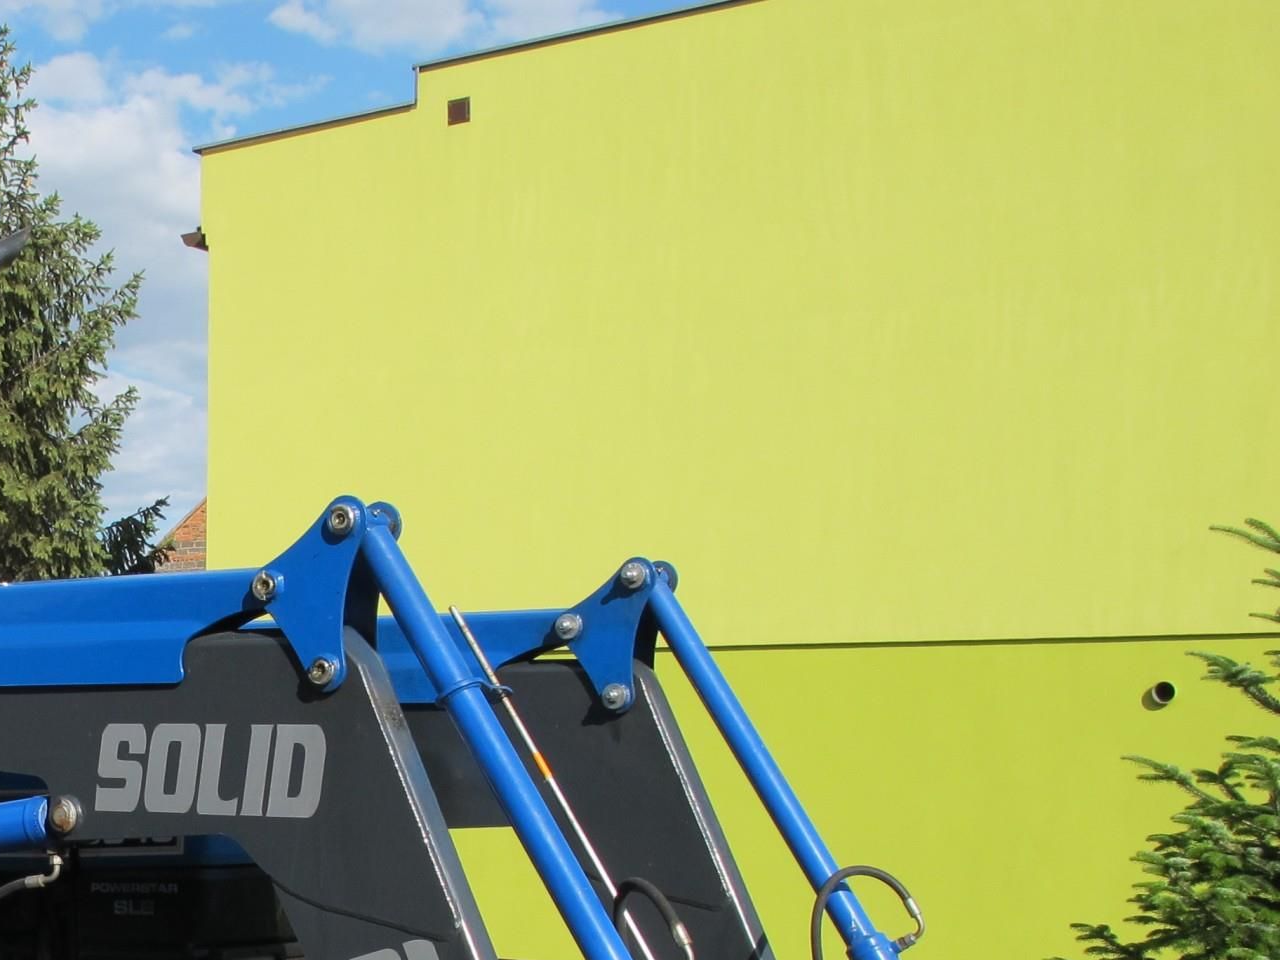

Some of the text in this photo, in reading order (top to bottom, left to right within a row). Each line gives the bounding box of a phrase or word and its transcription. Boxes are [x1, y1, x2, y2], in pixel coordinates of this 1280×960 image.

[95, 723, 327, 818] SOLID
[90, 881, 179, 894] POWERSTAR
[113, 899, 155, 916] SLE
